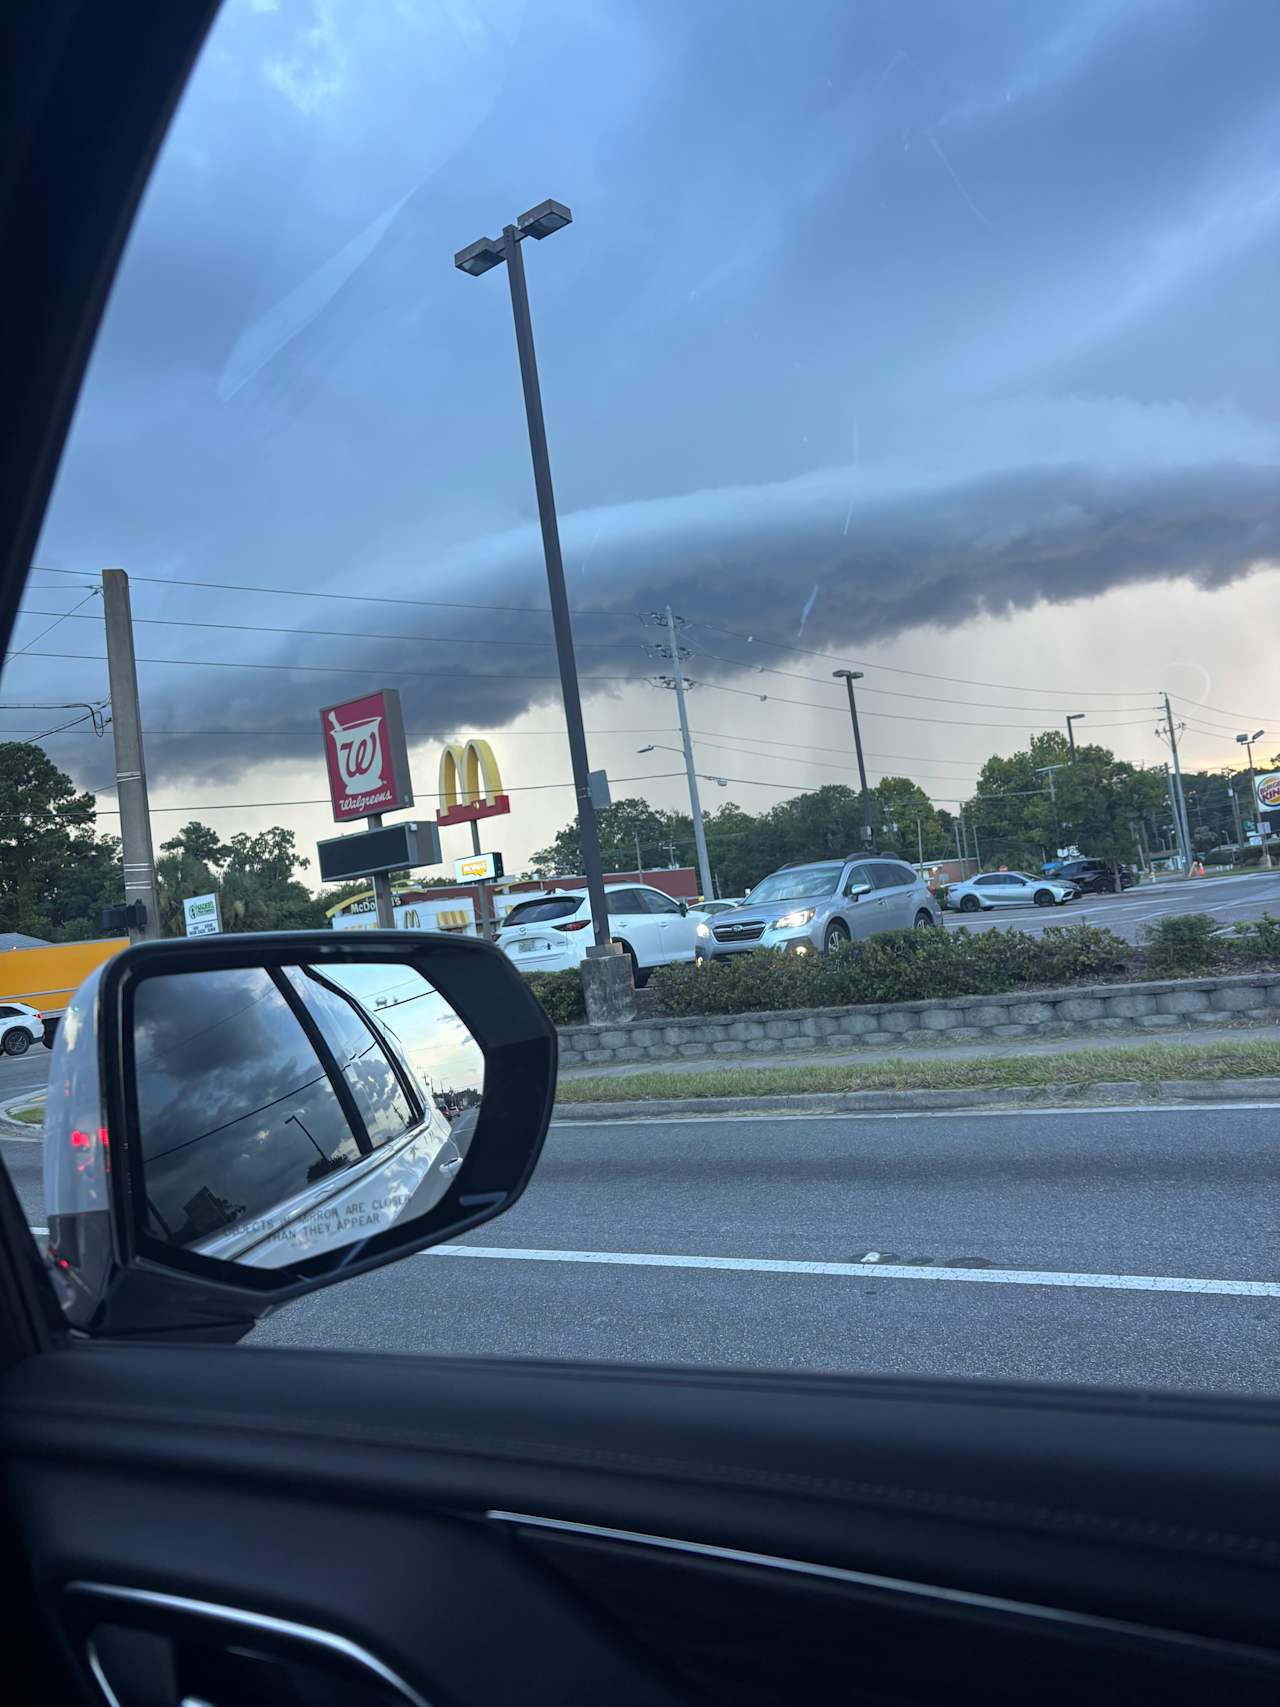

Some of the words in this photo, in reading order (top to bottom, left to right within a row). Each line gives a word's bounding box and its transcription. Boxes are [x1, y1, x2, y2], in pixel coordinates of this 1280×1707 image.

[339, 790, 392, 811] Walgreens
[350, 895, 401, 914] McDo's
[346, 1202, 365, 1215] ARE
[303, 1223, 332, 1237] THEY
[337, 1213, 380, 1231] APPEAR
